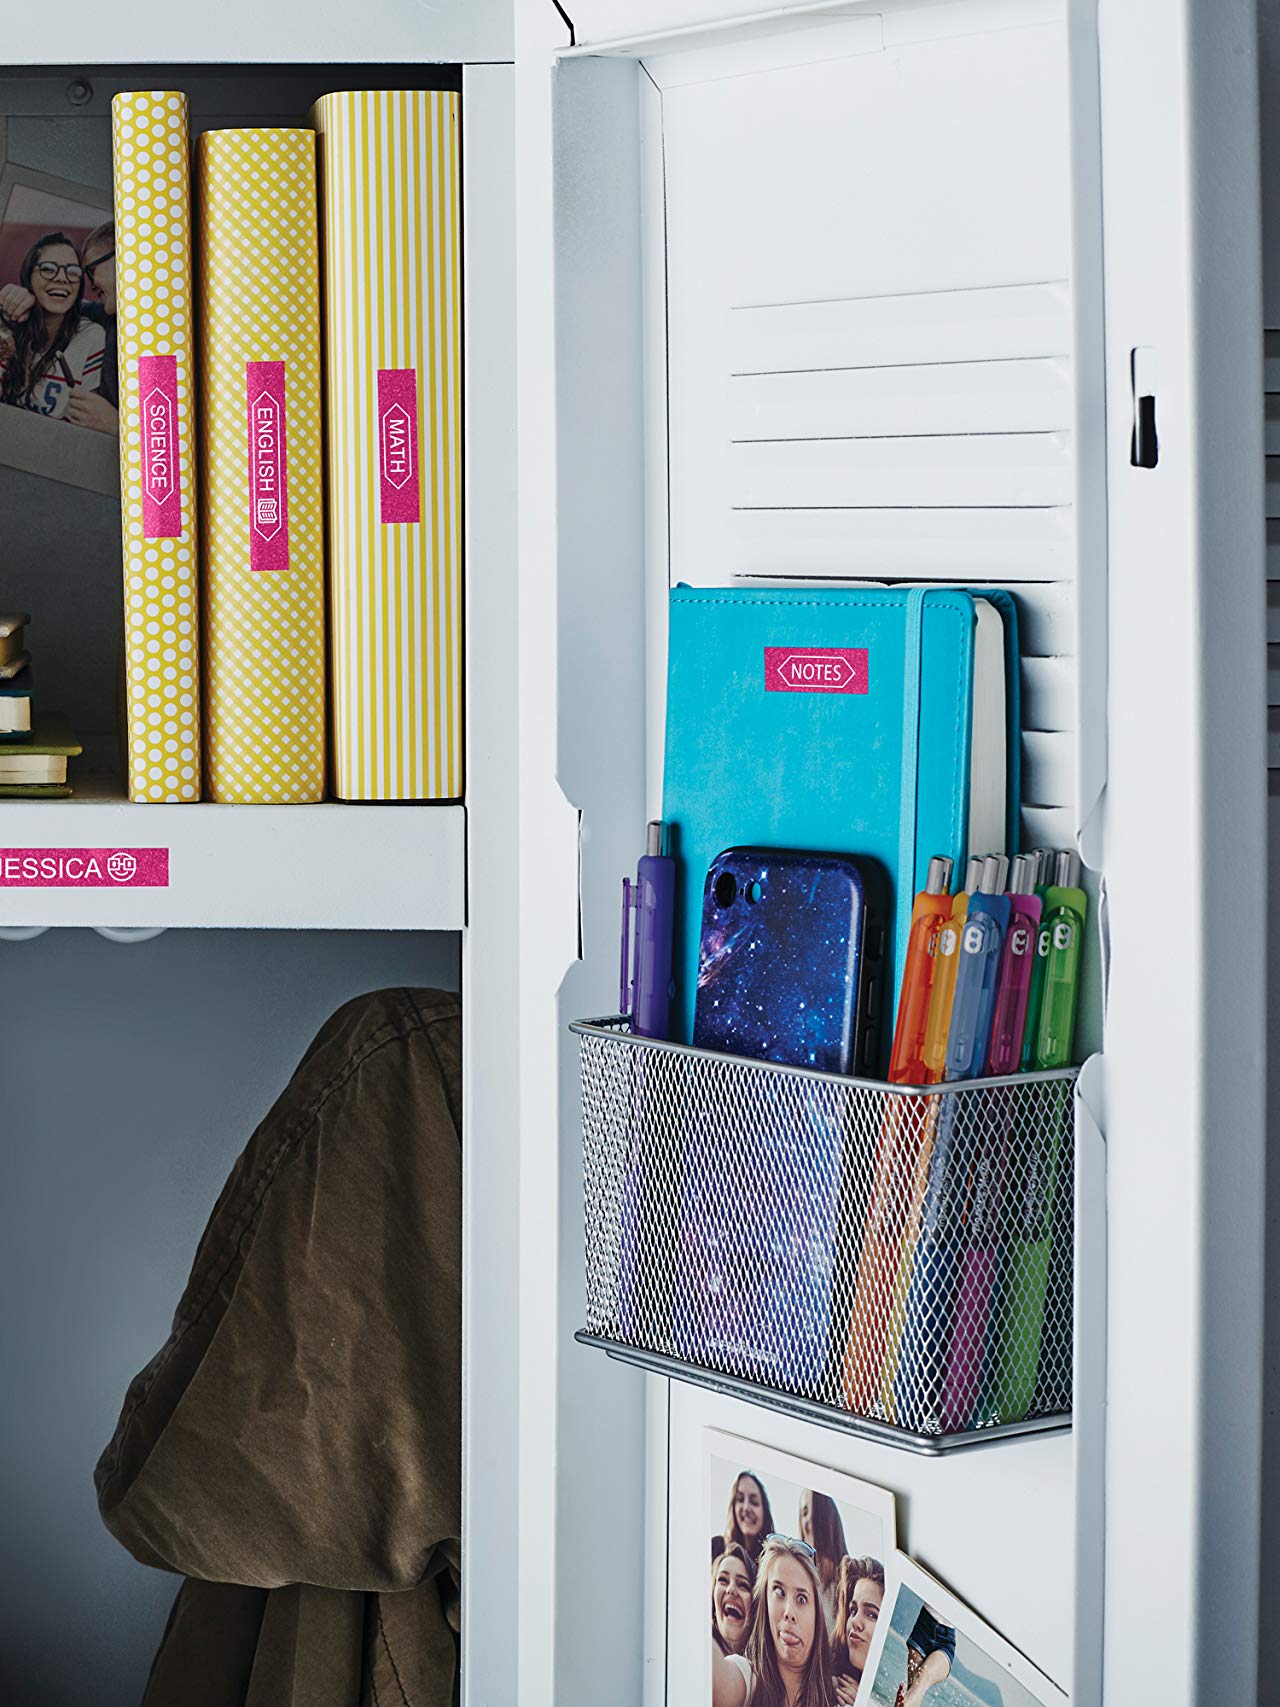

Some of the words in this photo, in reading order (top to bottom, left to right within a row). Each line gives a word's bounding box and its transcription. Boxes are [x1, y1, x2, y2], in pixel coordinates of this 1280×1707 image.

[150, 404, 168, 490] SCIENCE
[257, 407, 274, 492] ENGLISH
[389, 418, 406, 474] MATH
[791, 663, 841, 682] NOTES
